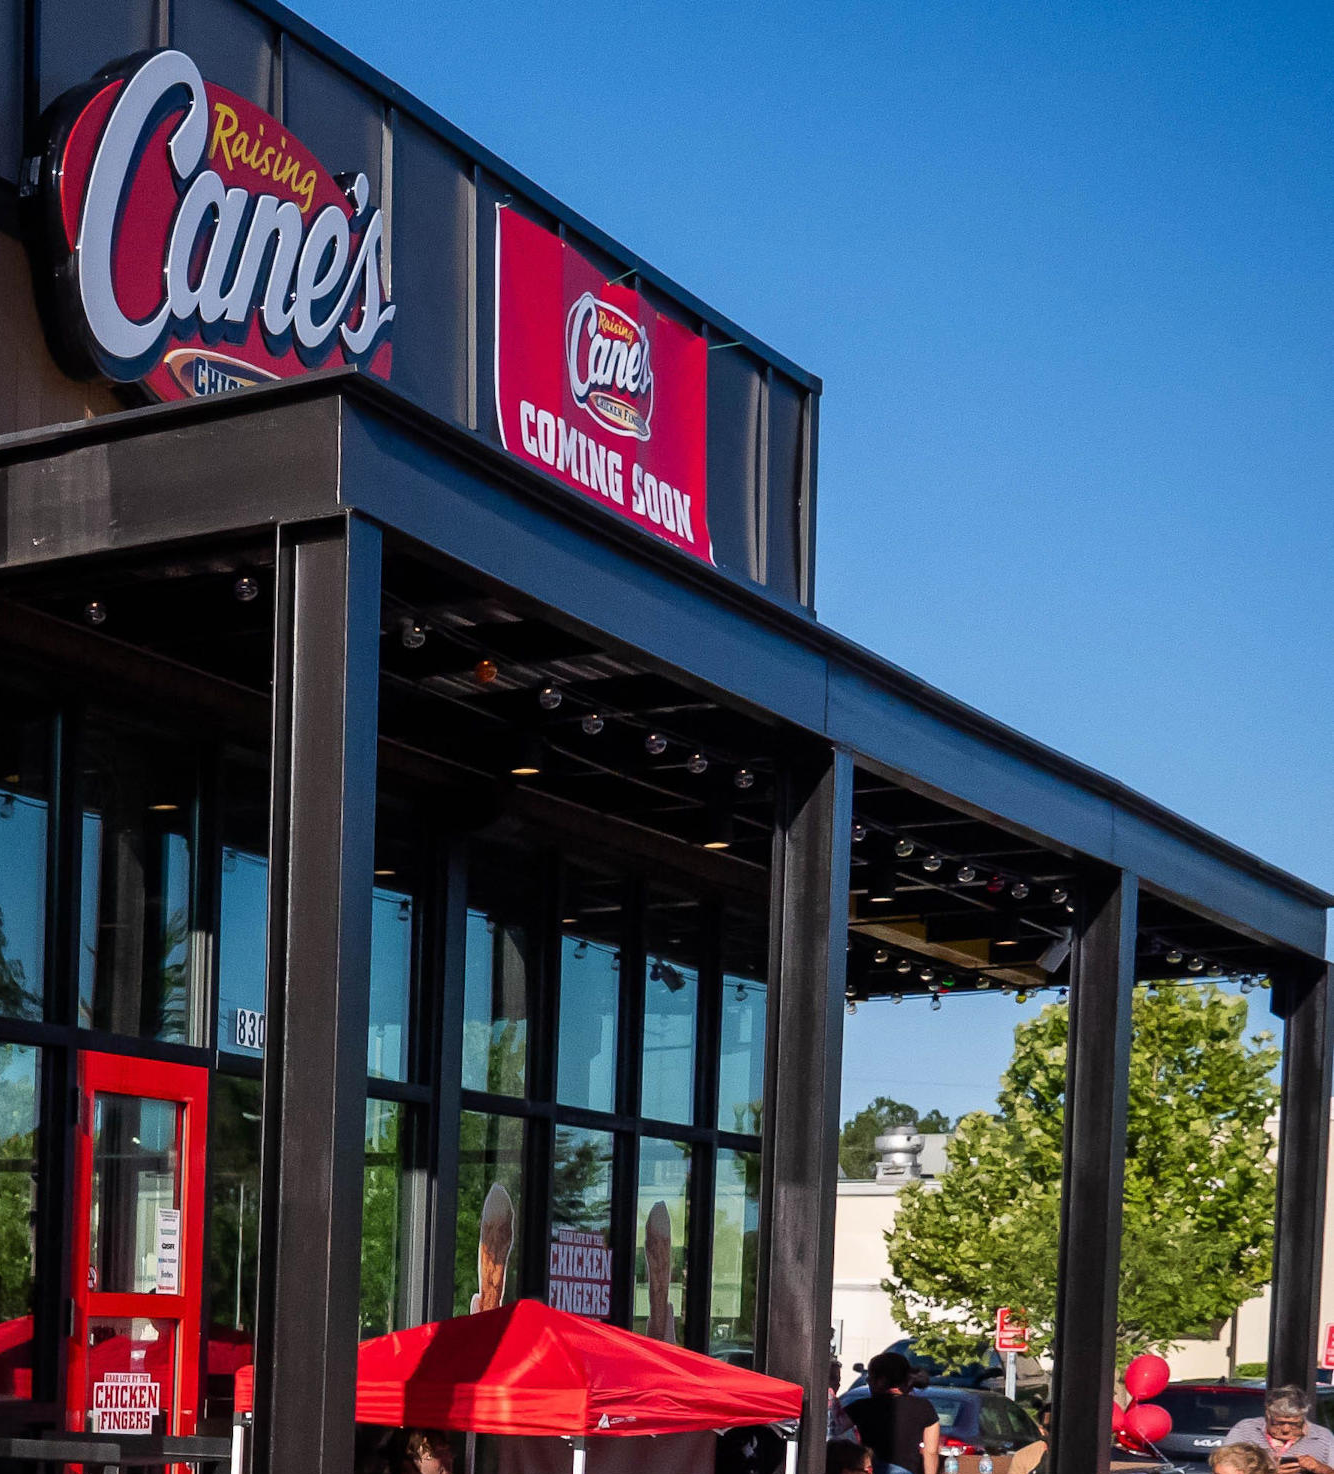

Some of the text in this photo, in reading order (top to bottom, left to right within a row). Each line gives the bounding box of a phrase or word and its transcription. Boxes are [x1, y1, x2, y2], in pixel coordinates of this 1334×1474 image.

[208, 102, 317, 213] Raising
[78, 49, 397, 359] Cane's
[570, 295, 651, 397] Cane's
[598, 310, 634, 345] Raising
[519, 399, 695, 544] COMING SOON
[549, 1243, 612, 1281] CHICKEN
[548, 1279, 611, 1316] FINGERS
[95, 1384, 158, 1409] CHICKEN
[100, 1411, 151, 1430] FINGERS
